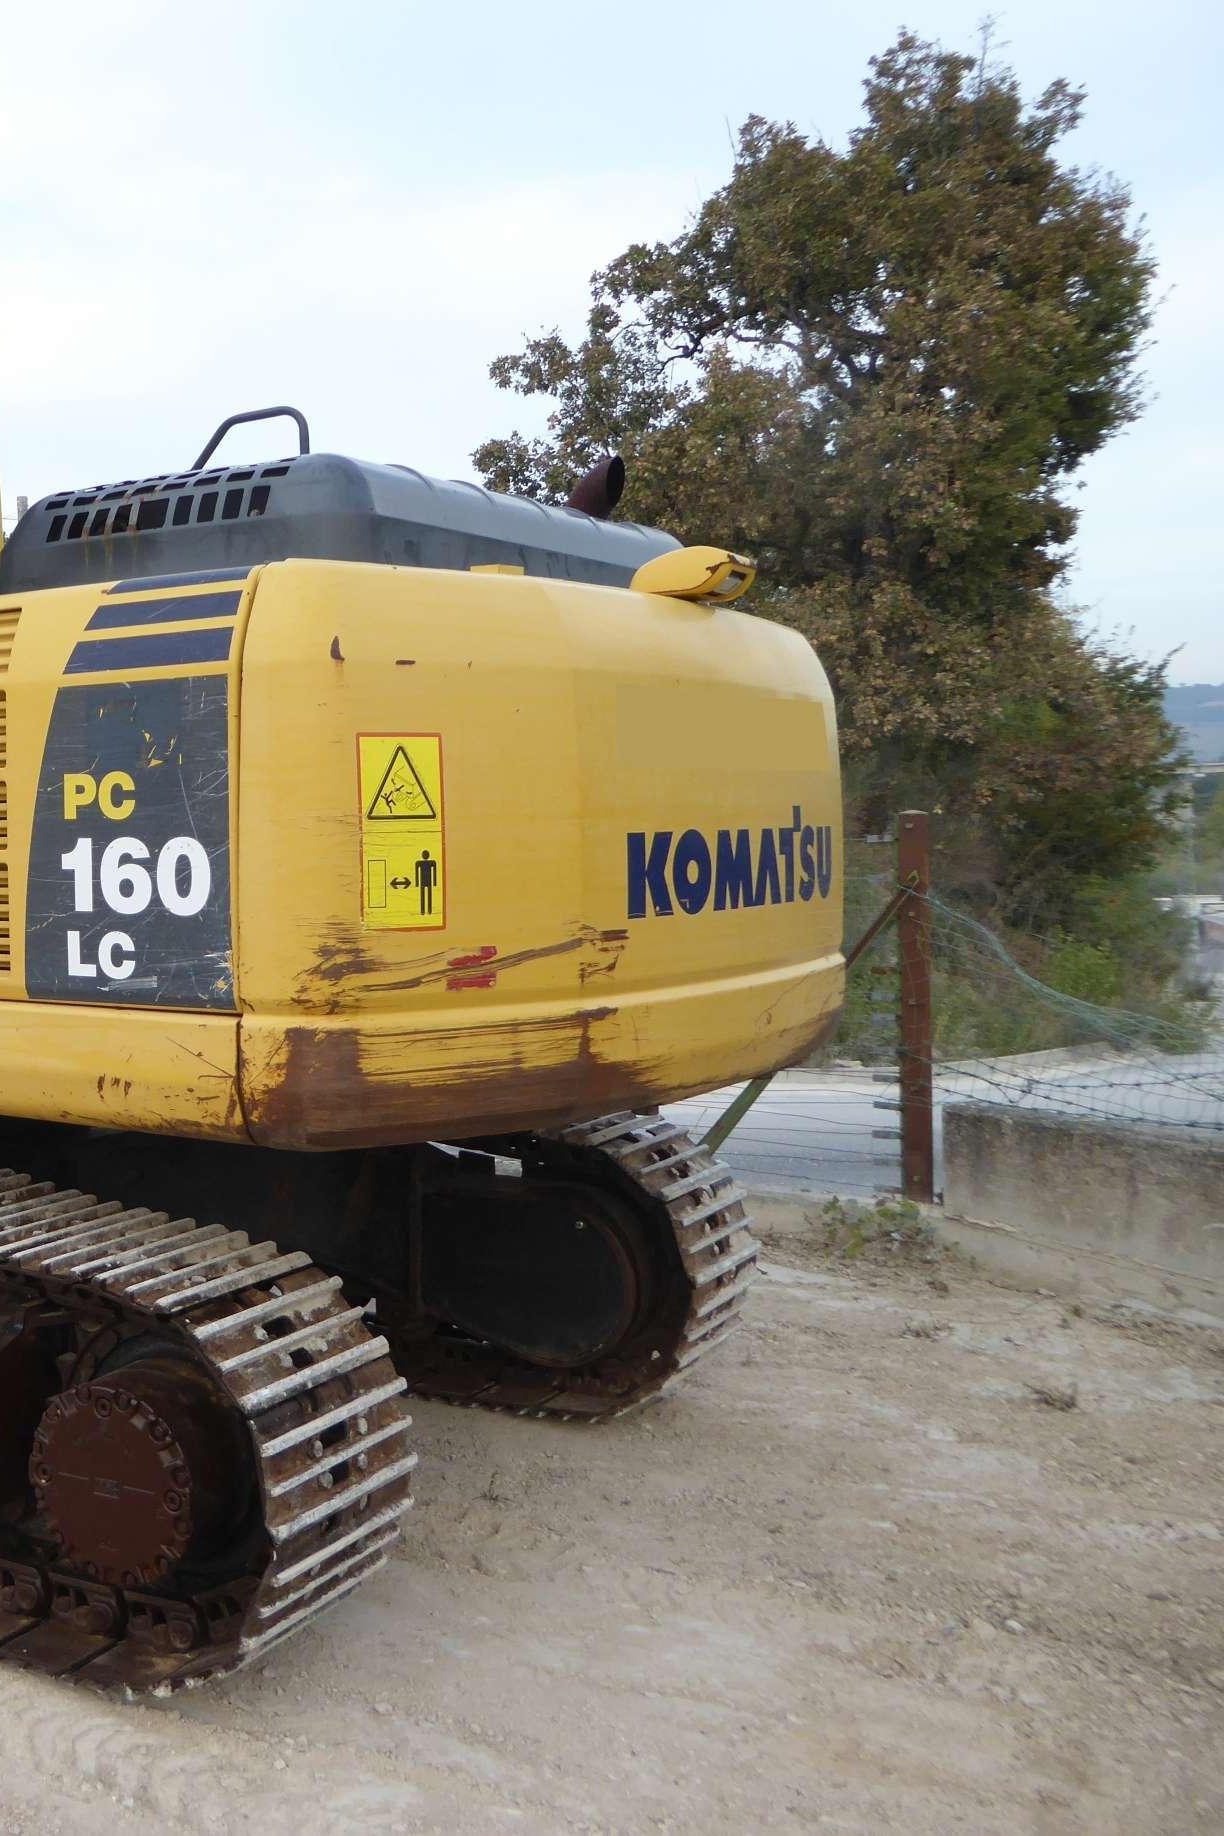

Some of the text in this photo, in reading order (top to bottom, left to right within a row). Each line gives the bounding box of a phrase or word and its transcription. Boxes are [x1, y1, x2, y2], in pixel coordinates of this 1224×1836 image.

[63, 771, 136, 820] PC
[61, 836, 211, 916] 160
[627, 805, 832, 919] KOMATSU
[66, 930, 136, 979] LC
